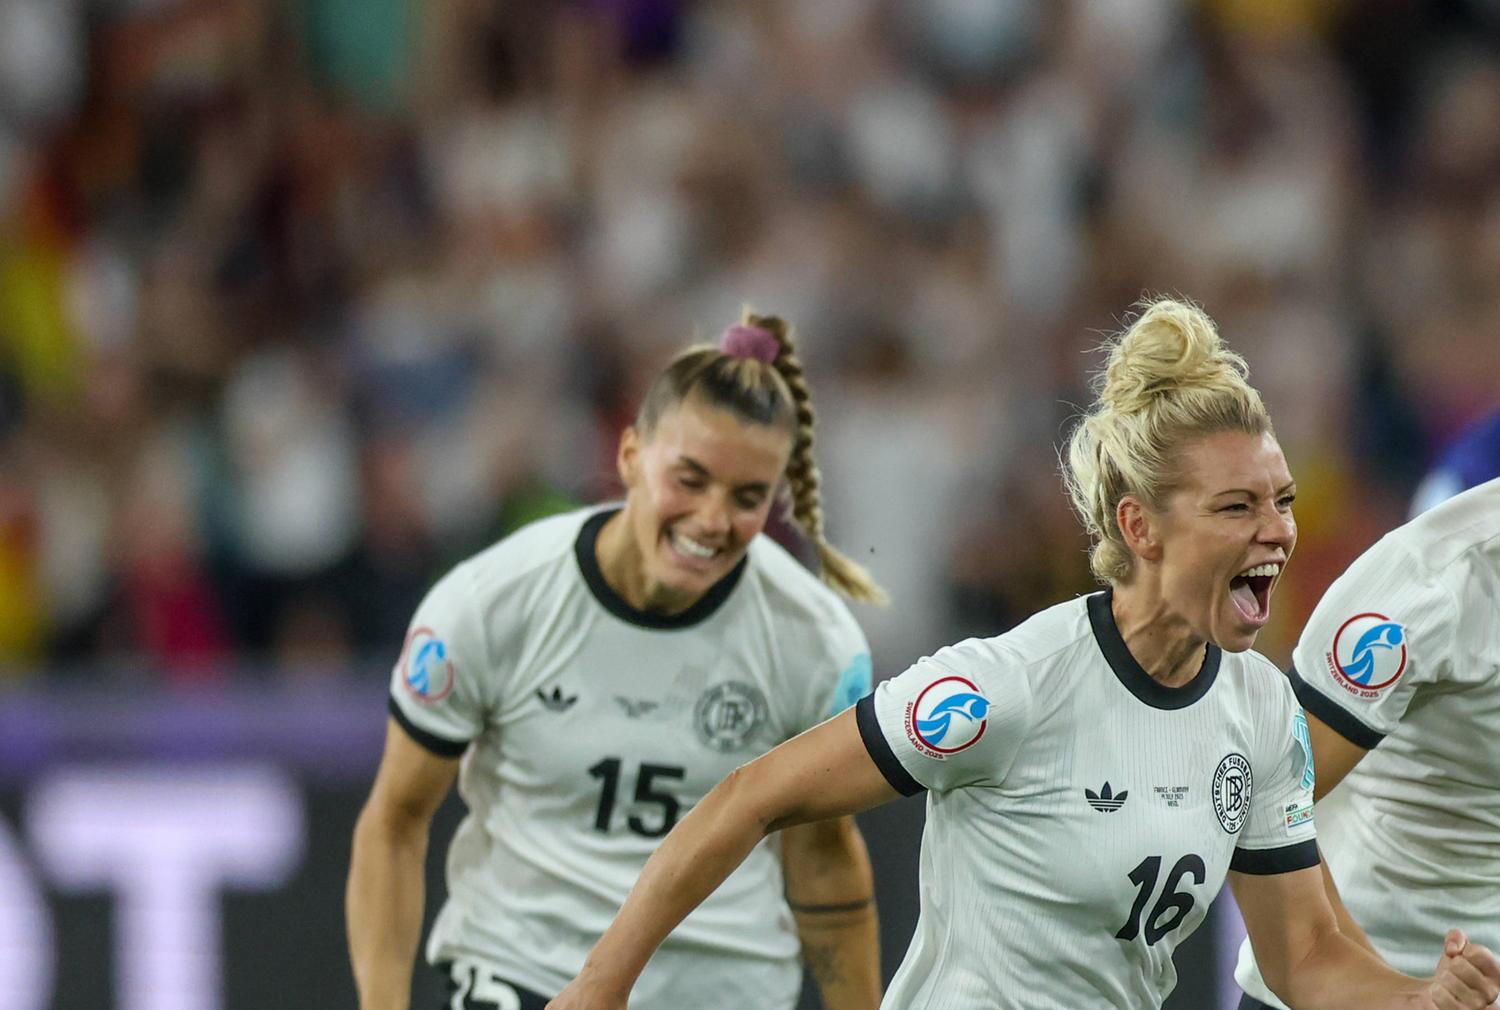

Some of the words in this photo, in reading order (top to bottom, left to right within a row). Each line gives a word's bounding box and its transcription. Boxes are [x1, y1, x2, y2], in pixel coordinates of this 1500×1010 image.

[1326, 651, 1359, 695] SWITZERLAND
[1360, 690, 1379, 698] 2025
[904, 701, 924, 752] SWITZERLAND
[924, 749, 944, 760] 2025
[587, 757, 685, 838] 15
[1114, 853, 1206, 947] 16
